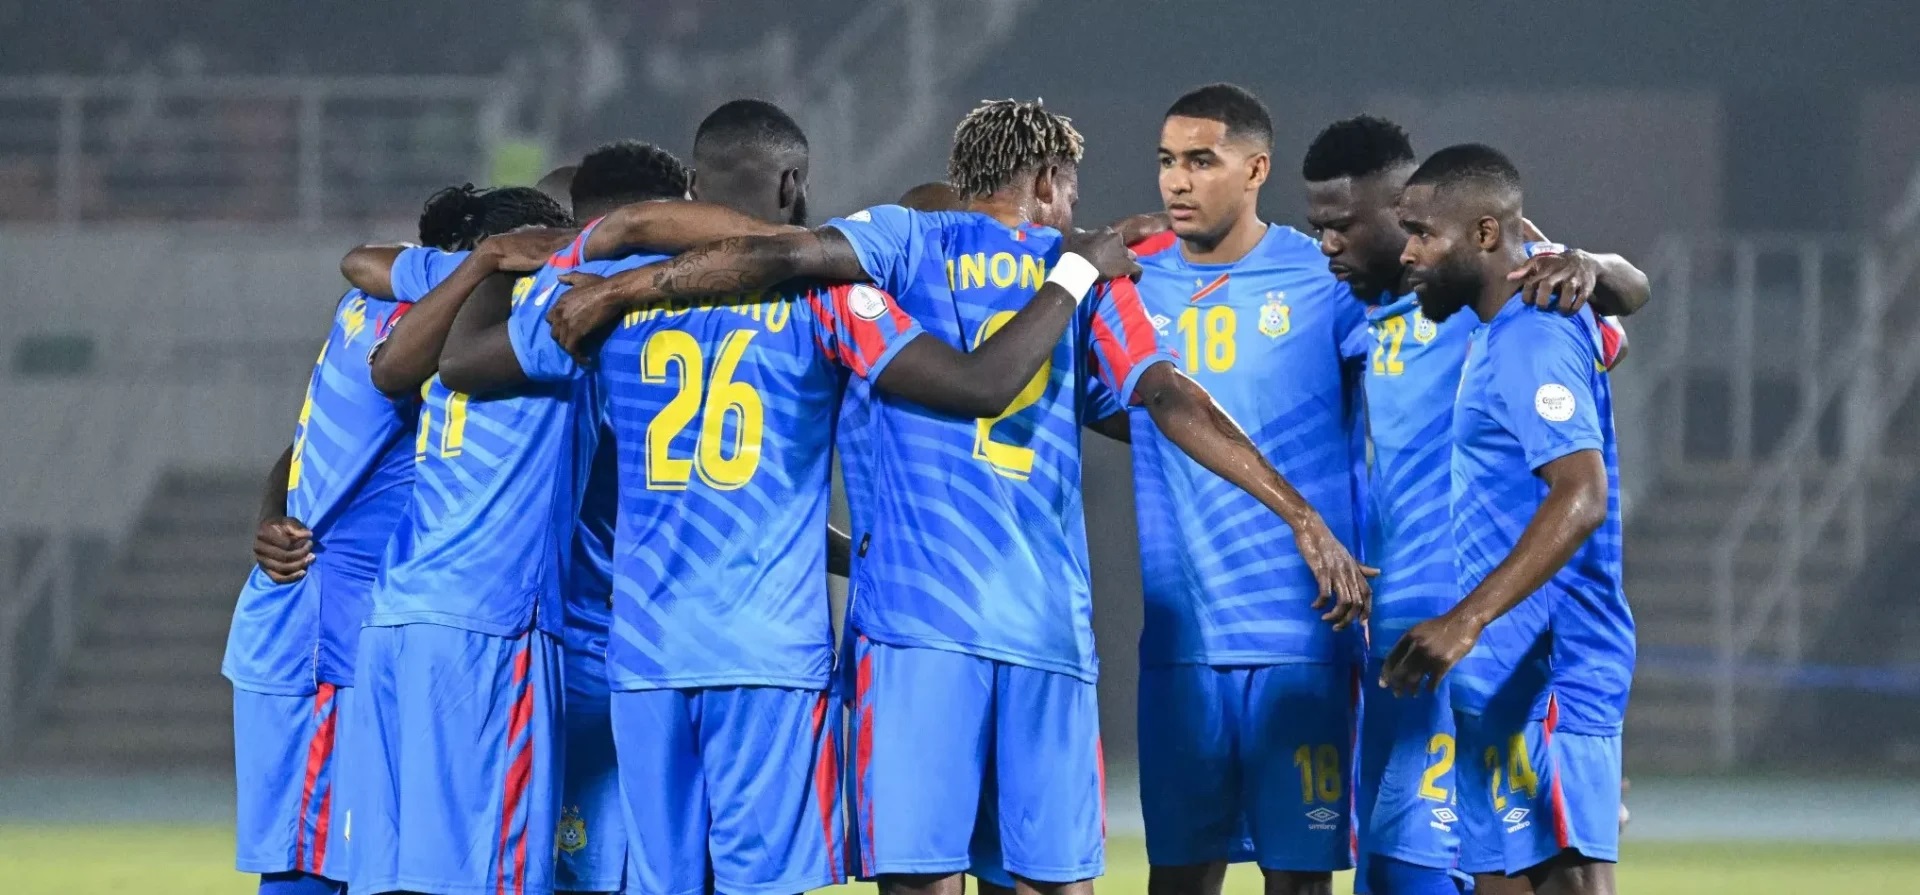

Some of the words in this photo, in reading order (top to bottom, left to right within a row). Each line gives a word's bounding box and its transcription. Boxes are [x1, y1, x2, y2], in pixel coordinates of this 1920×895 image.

[1177, 305, 1238, 373] 18
[1373, 315, 1406, 376] 22
[641, 329, 763, 490] 26
[1294, 743, 1342, 805] 18
[1418, 733, 1457, 806] 2
[1484, 731, 1539, 813] 24
[1307, 822, 1337, 831] umbro
[1506, 820, 1531, 834] umbro
